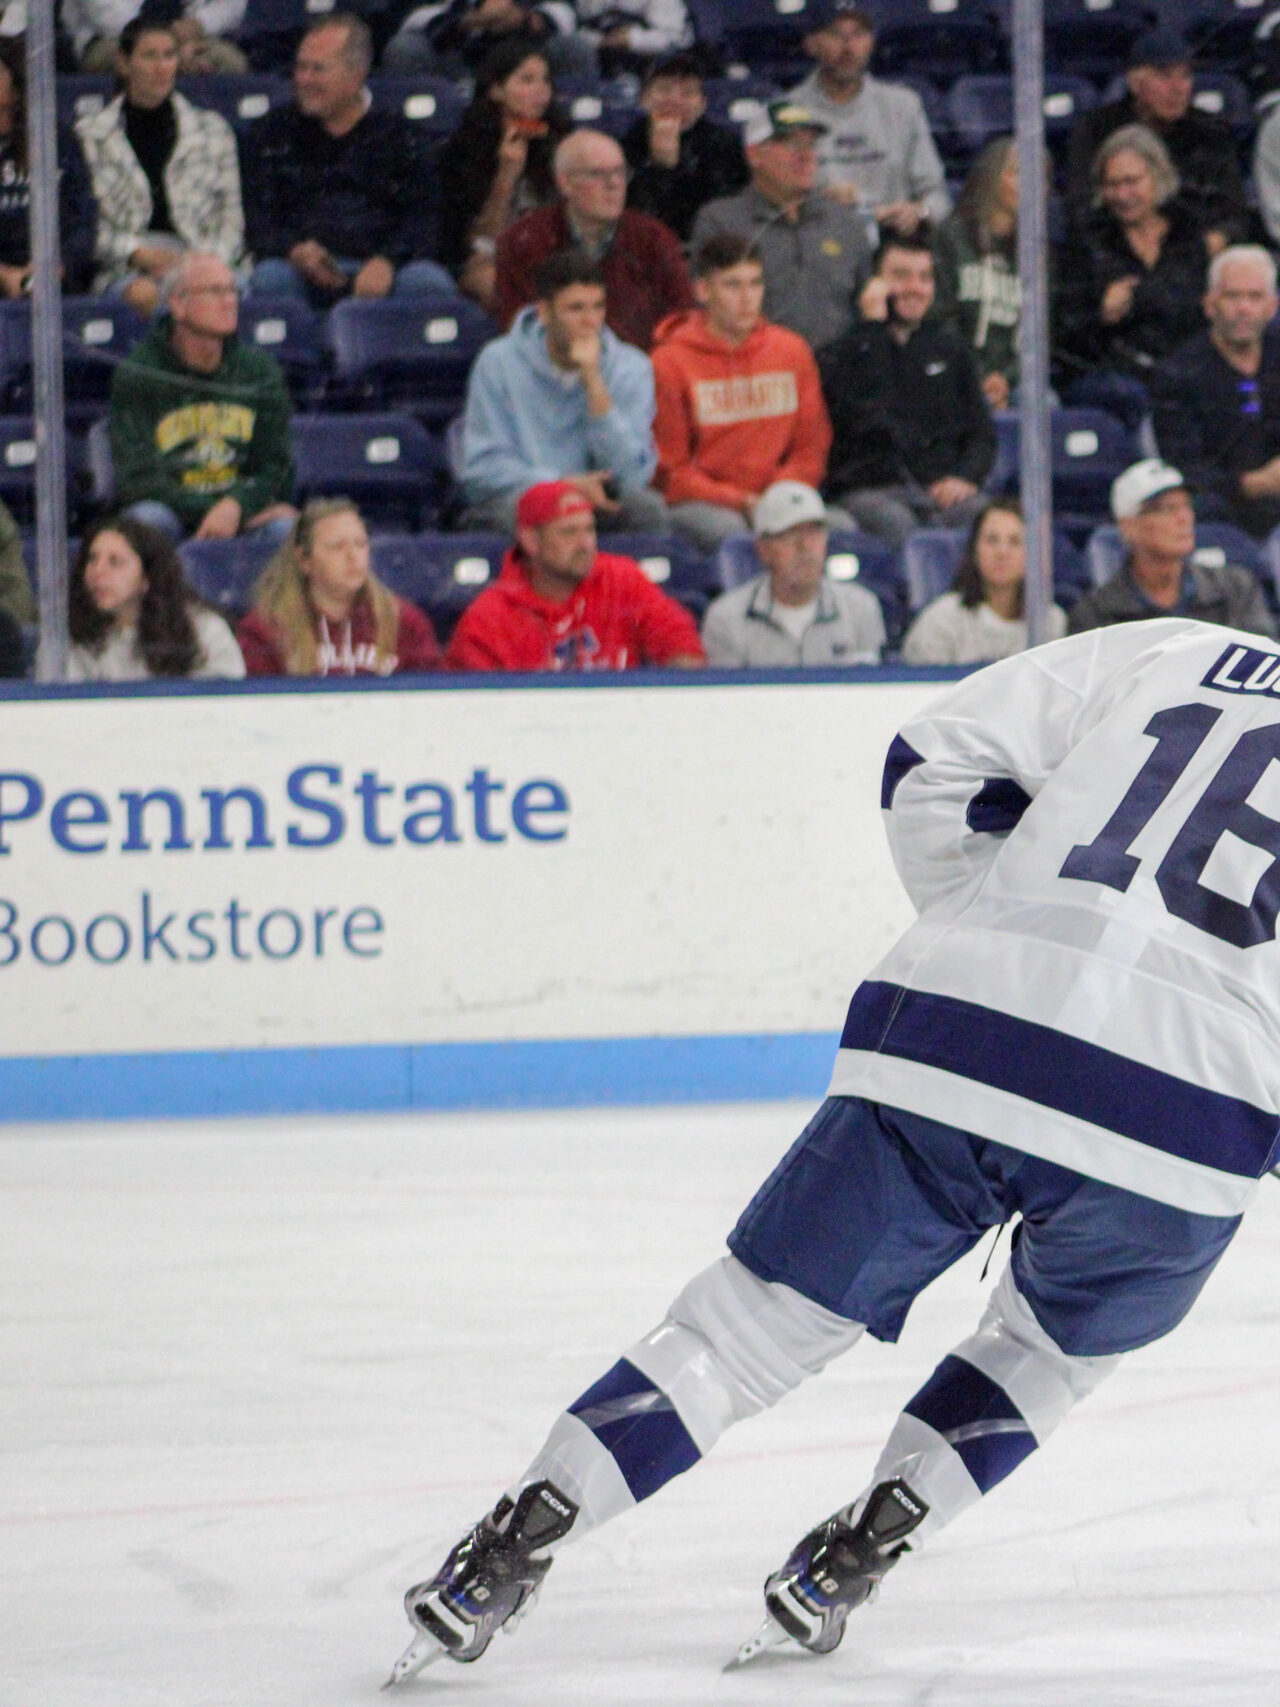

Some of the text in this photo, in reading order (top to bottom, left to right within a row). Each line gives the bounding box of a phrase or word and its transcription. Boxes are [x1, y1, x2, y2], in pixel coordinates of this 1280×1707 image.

[0, 763, 571, 857] PennState
[540, 1489, 570, 1517] CCM
[892, 1487, 921, 1515] CCM
